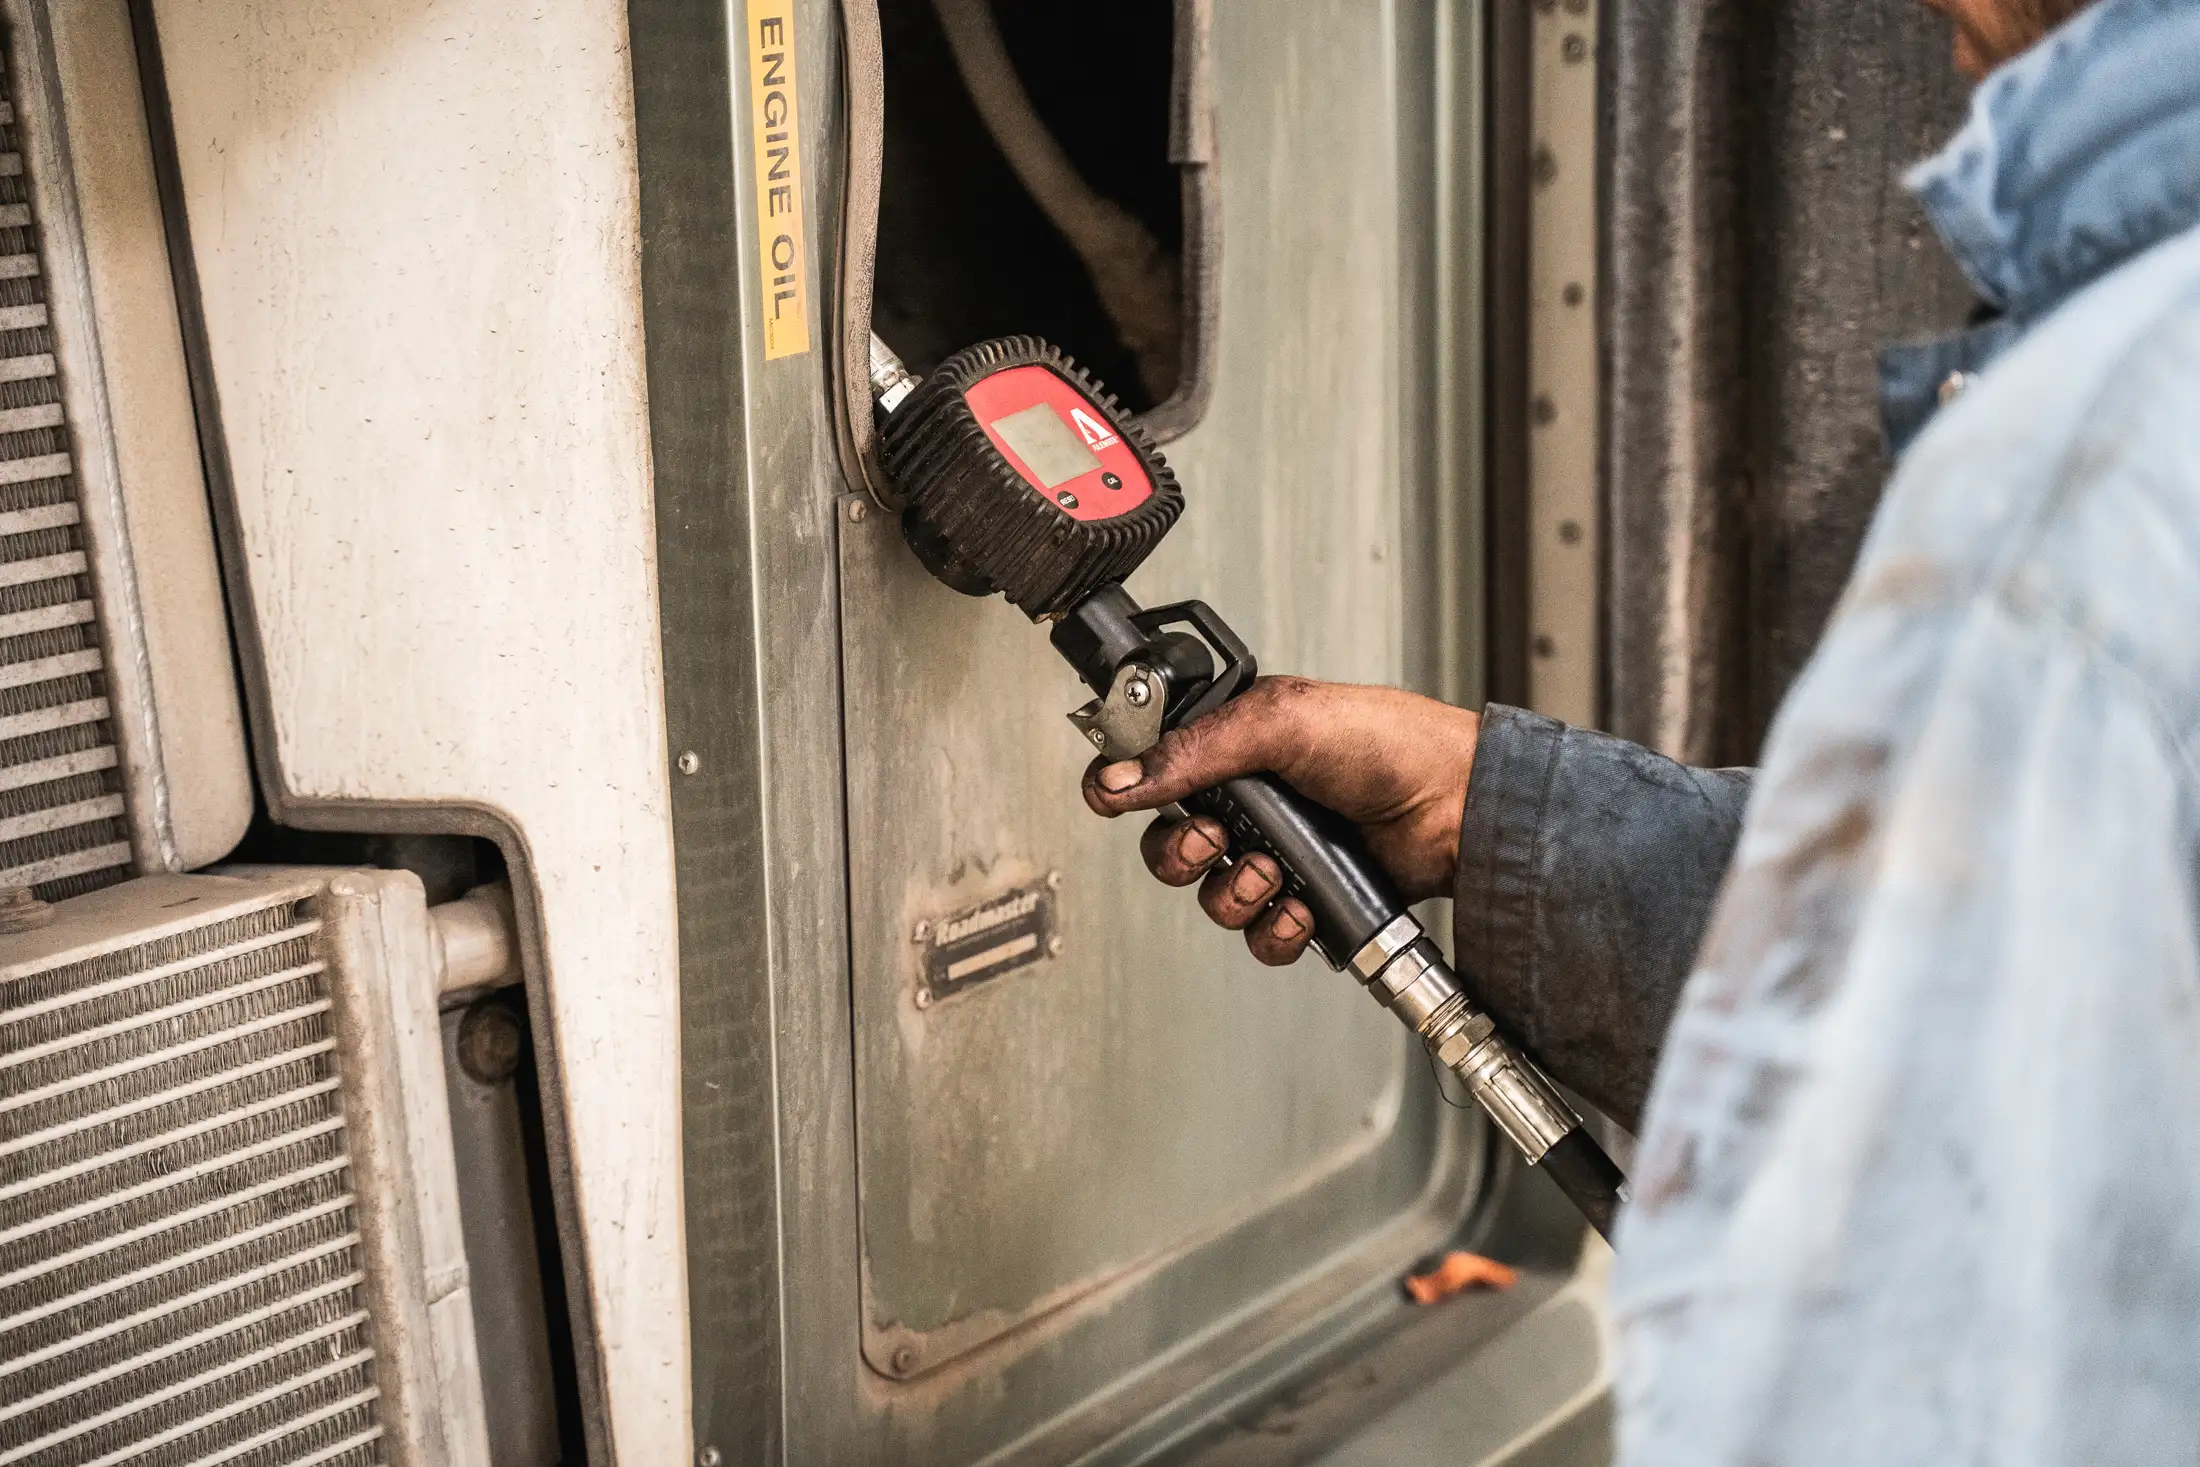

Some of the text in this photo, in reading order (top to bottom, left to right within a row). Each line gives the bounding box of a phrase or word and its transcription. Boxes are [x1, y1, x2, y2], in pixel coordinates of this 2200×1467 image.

[760, 17, 796, 320] ENGINE OIL
[1092, 436, 1119, 452] ALEMITE
[1060, 495, 1075, 505] RESET
[934, 890, 1041, 948] Roadmaster
